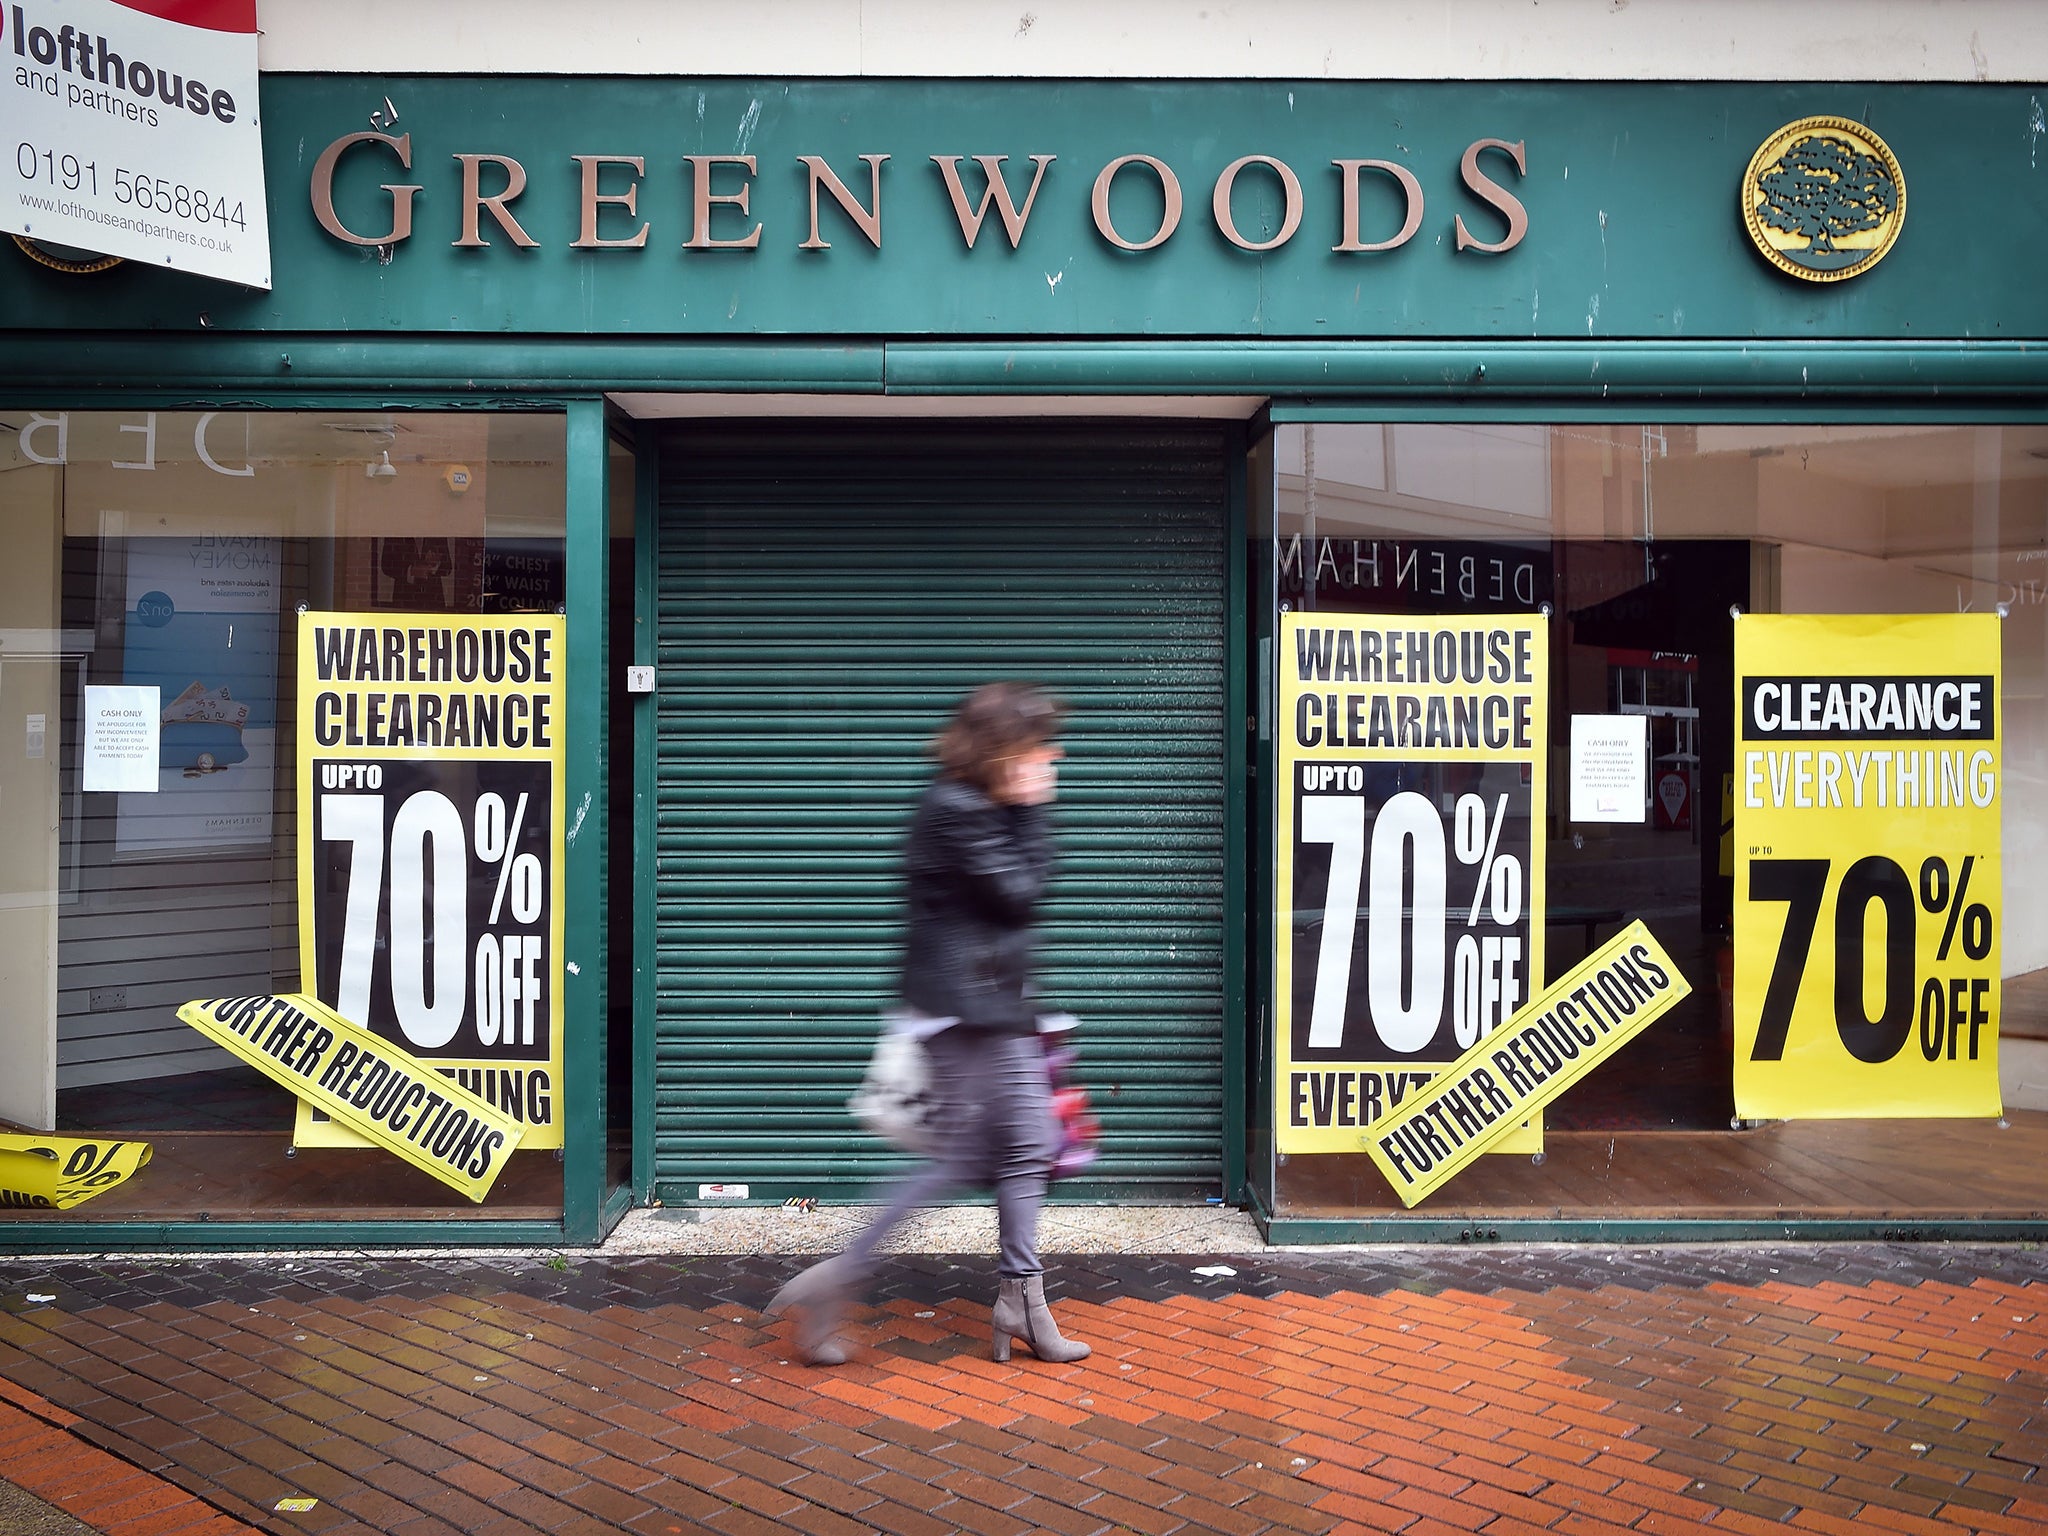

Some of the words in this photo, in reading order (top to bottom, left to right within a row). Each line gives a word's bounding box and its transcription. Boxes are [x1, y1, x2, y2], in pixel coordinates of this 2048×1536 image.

[12, 4, 236, 124] lofthouse
[16, 66, 58, 97] and
[68, 82, 158, 127] partners
[17, 142, 97, 196] 0191
[115, 168, 247, 233] 5658844
[19, 192, 233, 253] www.lofthouseandpartners.co.uk
[504, 575, 551, 592] WAIST
[505, 556, 551, 572] CHEST
[314, 627, 552, 684] WAREHOUSE
[1296, 628, 1533, 684] WAREHOUSE
[100, 709, 121, 718] CASH
[123, 709, 143, 718] ONLY
[314, 691, 552, 749] CLEARANCE
[1296, 693, 1532, 750] CLEARANCE
[1753, 682, 1982, 732] CLEARANCE
[1744, 750, 1996, 809] EVERYTHING
[1748, 846, 1760, 856] UP
[1762, 846, 1773, 856] TO
[475, 932, 542, 1047] OFF
[1453, 933, 1522, 1050] OFF
[1919, 977, 1990, 1062] OFF
[1378, 1067, 1513, 1185] FURTHER
[1491, 944, 1670, 1099] REDUCTIONS
[318, 1041, 505, 1180] REDUCTIONS
